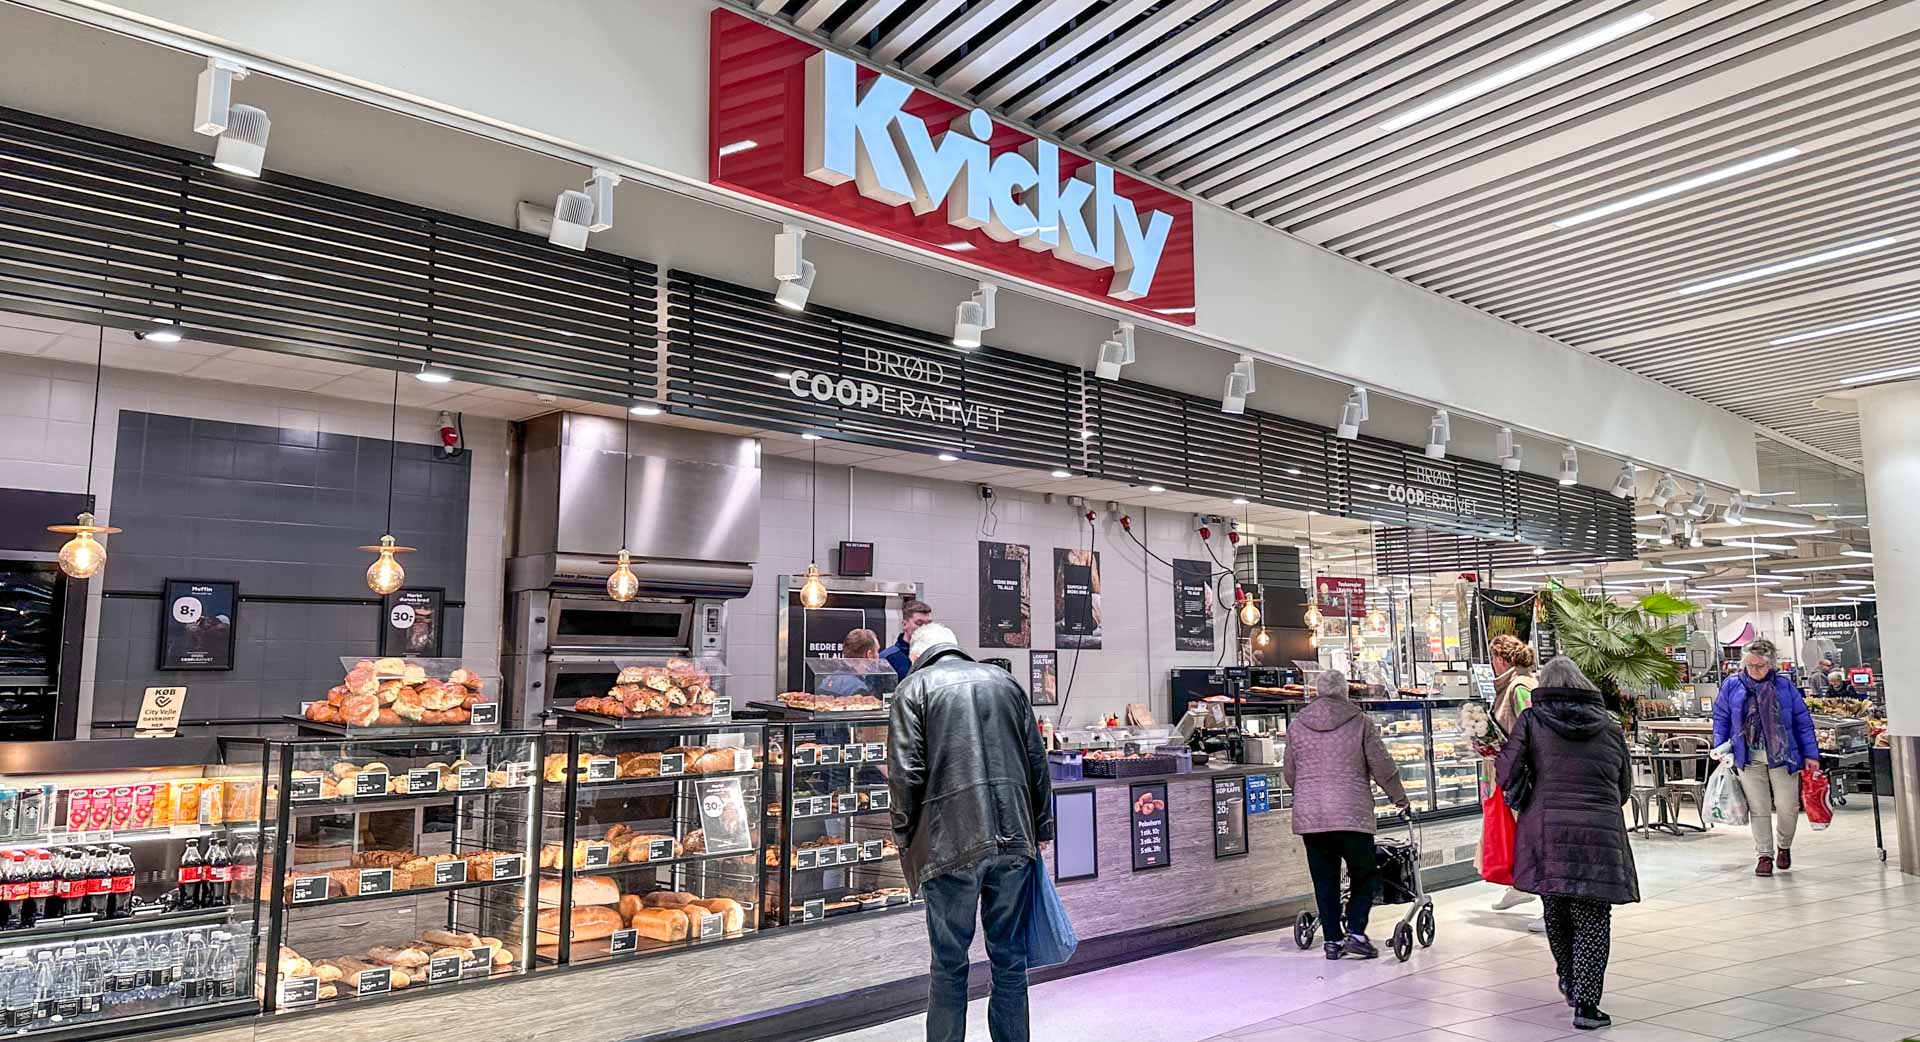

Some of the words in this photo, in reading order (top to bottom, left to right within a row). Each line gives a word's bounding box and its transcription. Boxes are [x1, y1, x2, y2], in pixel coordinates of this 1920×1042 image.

[805, 50, 1174, 299] Kvickly
[864, 347, 944, 385] BRØD
[789, 370, 1004, 431] COOPERATIVET
[1416, 466, 1450, 487] BRØD
[1388, 484, 1478, 516] COOPERATIVET
[810, 643, 836, 651] BEDRE
